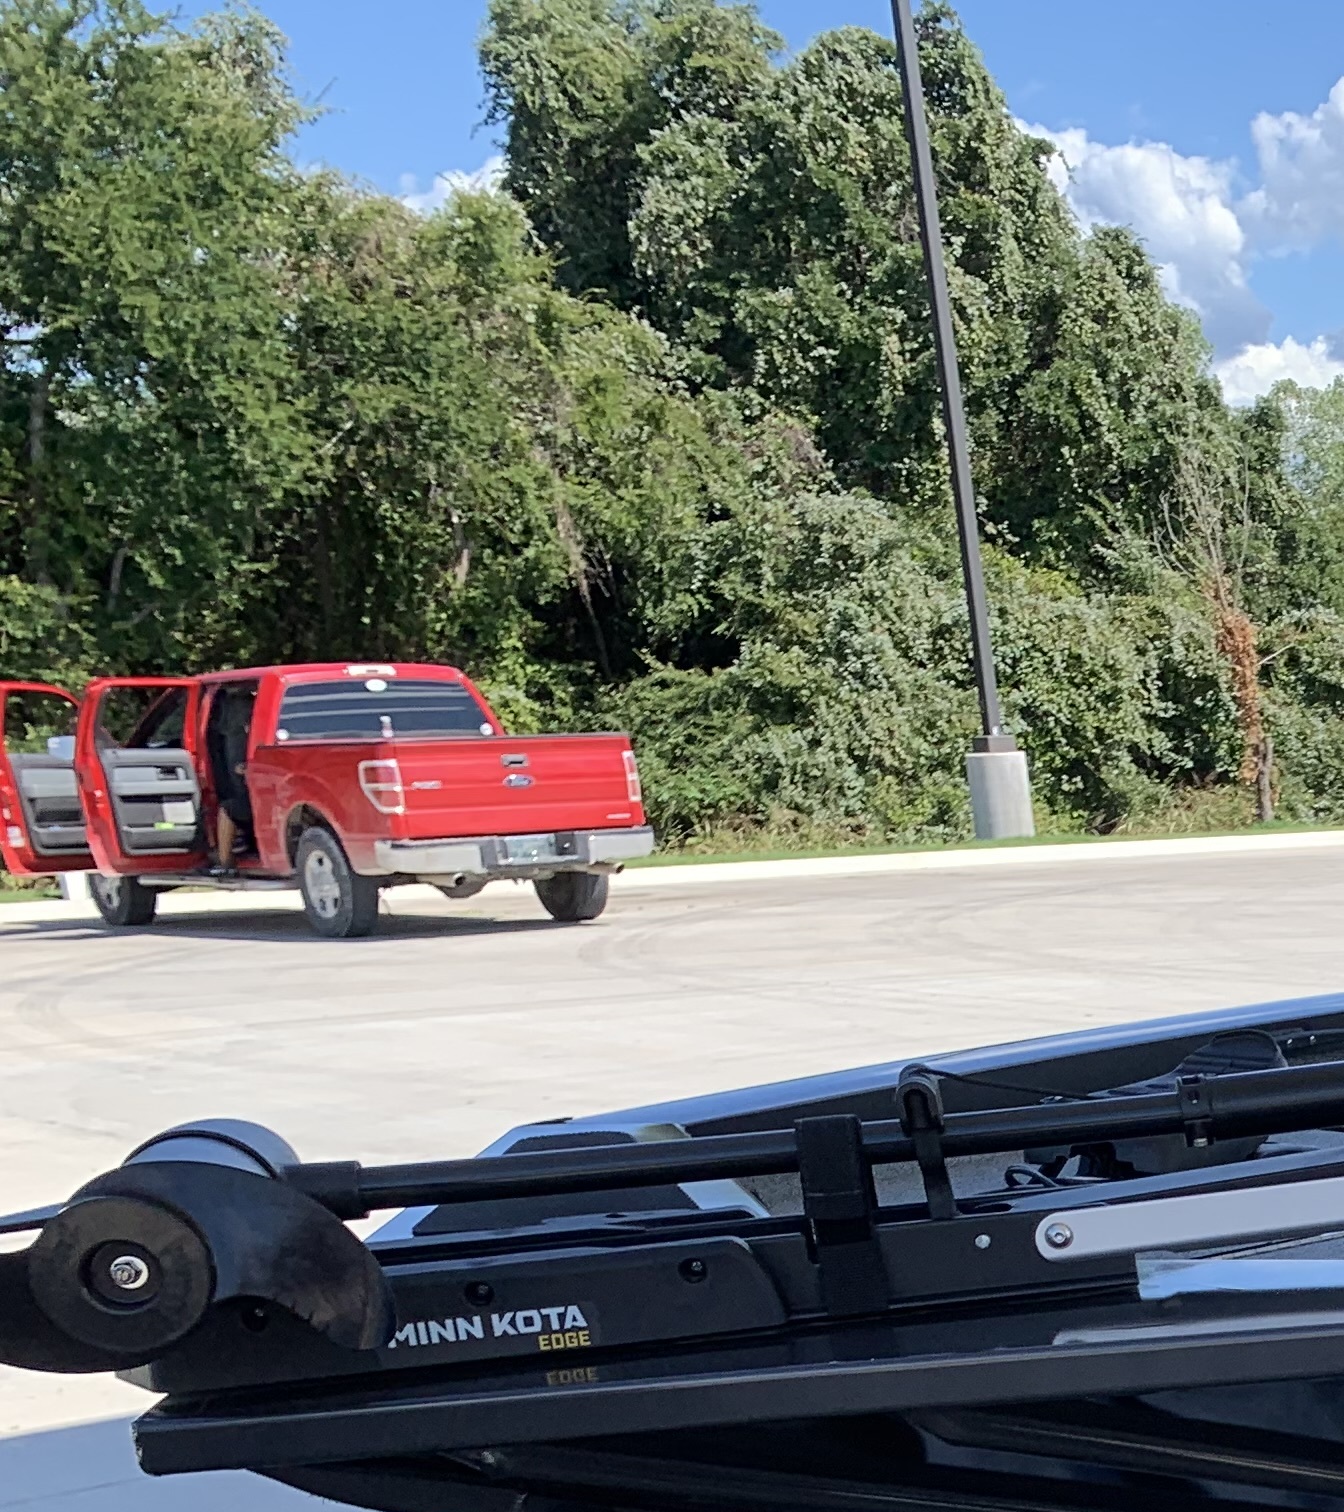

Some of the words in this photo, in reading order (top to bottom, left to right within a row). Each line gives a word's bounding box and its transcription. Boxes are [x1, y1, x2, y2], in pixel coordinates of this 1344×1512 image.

[387, 1314, 484, 1349] MINN
[491, 1304, 589, 1338] KOTA
[538, 1330, 592, 1351] EDGE
